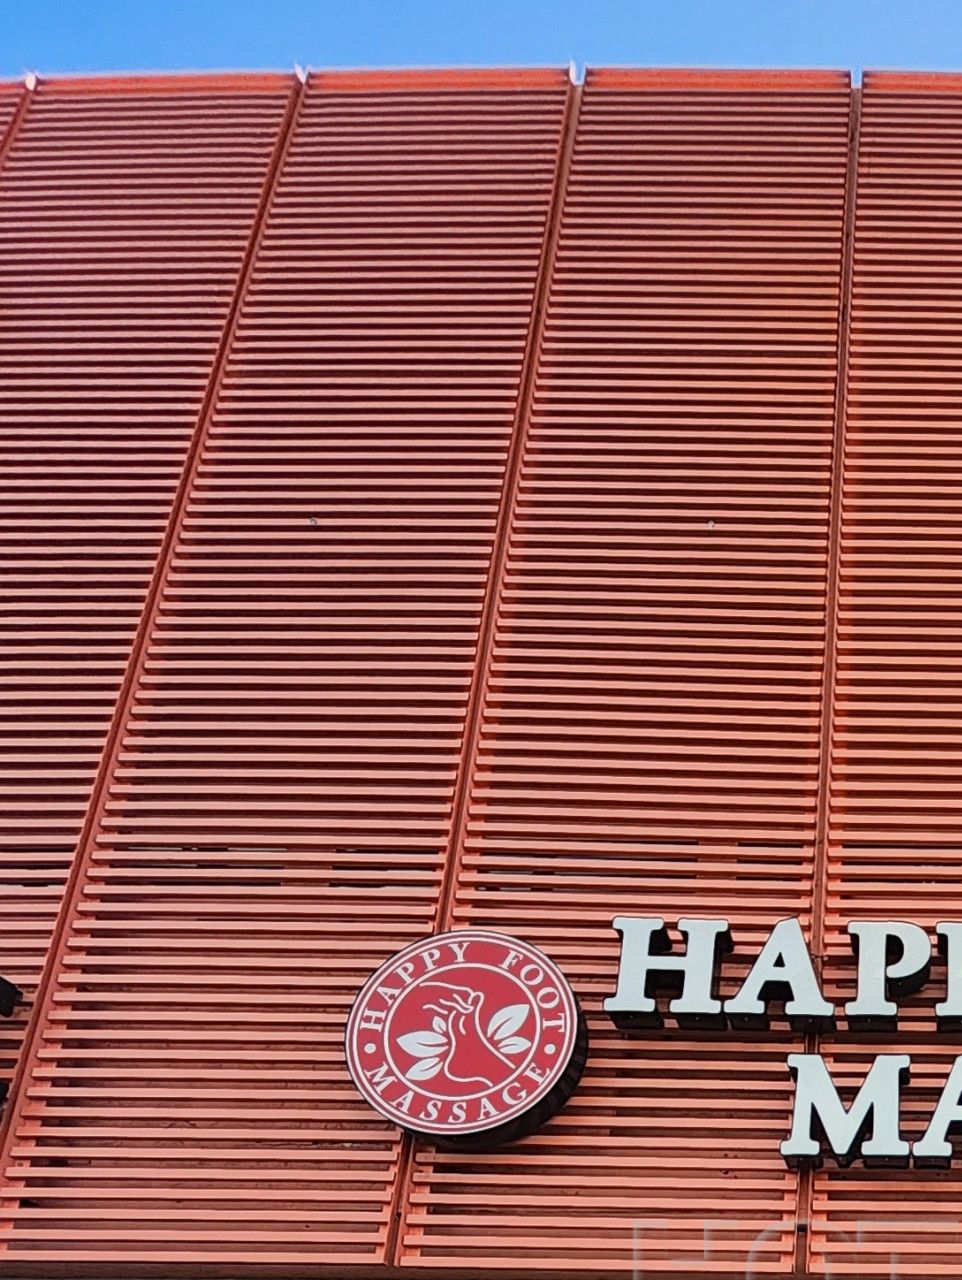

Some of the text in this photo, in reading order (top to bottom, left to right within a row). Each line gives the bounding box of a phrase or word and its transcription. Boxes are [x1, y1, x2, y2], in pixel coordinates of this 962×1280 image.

[360, 939, 565, 1034] HAPPY FOOT
[363, 1062, 553, 1124] MASSAGE
